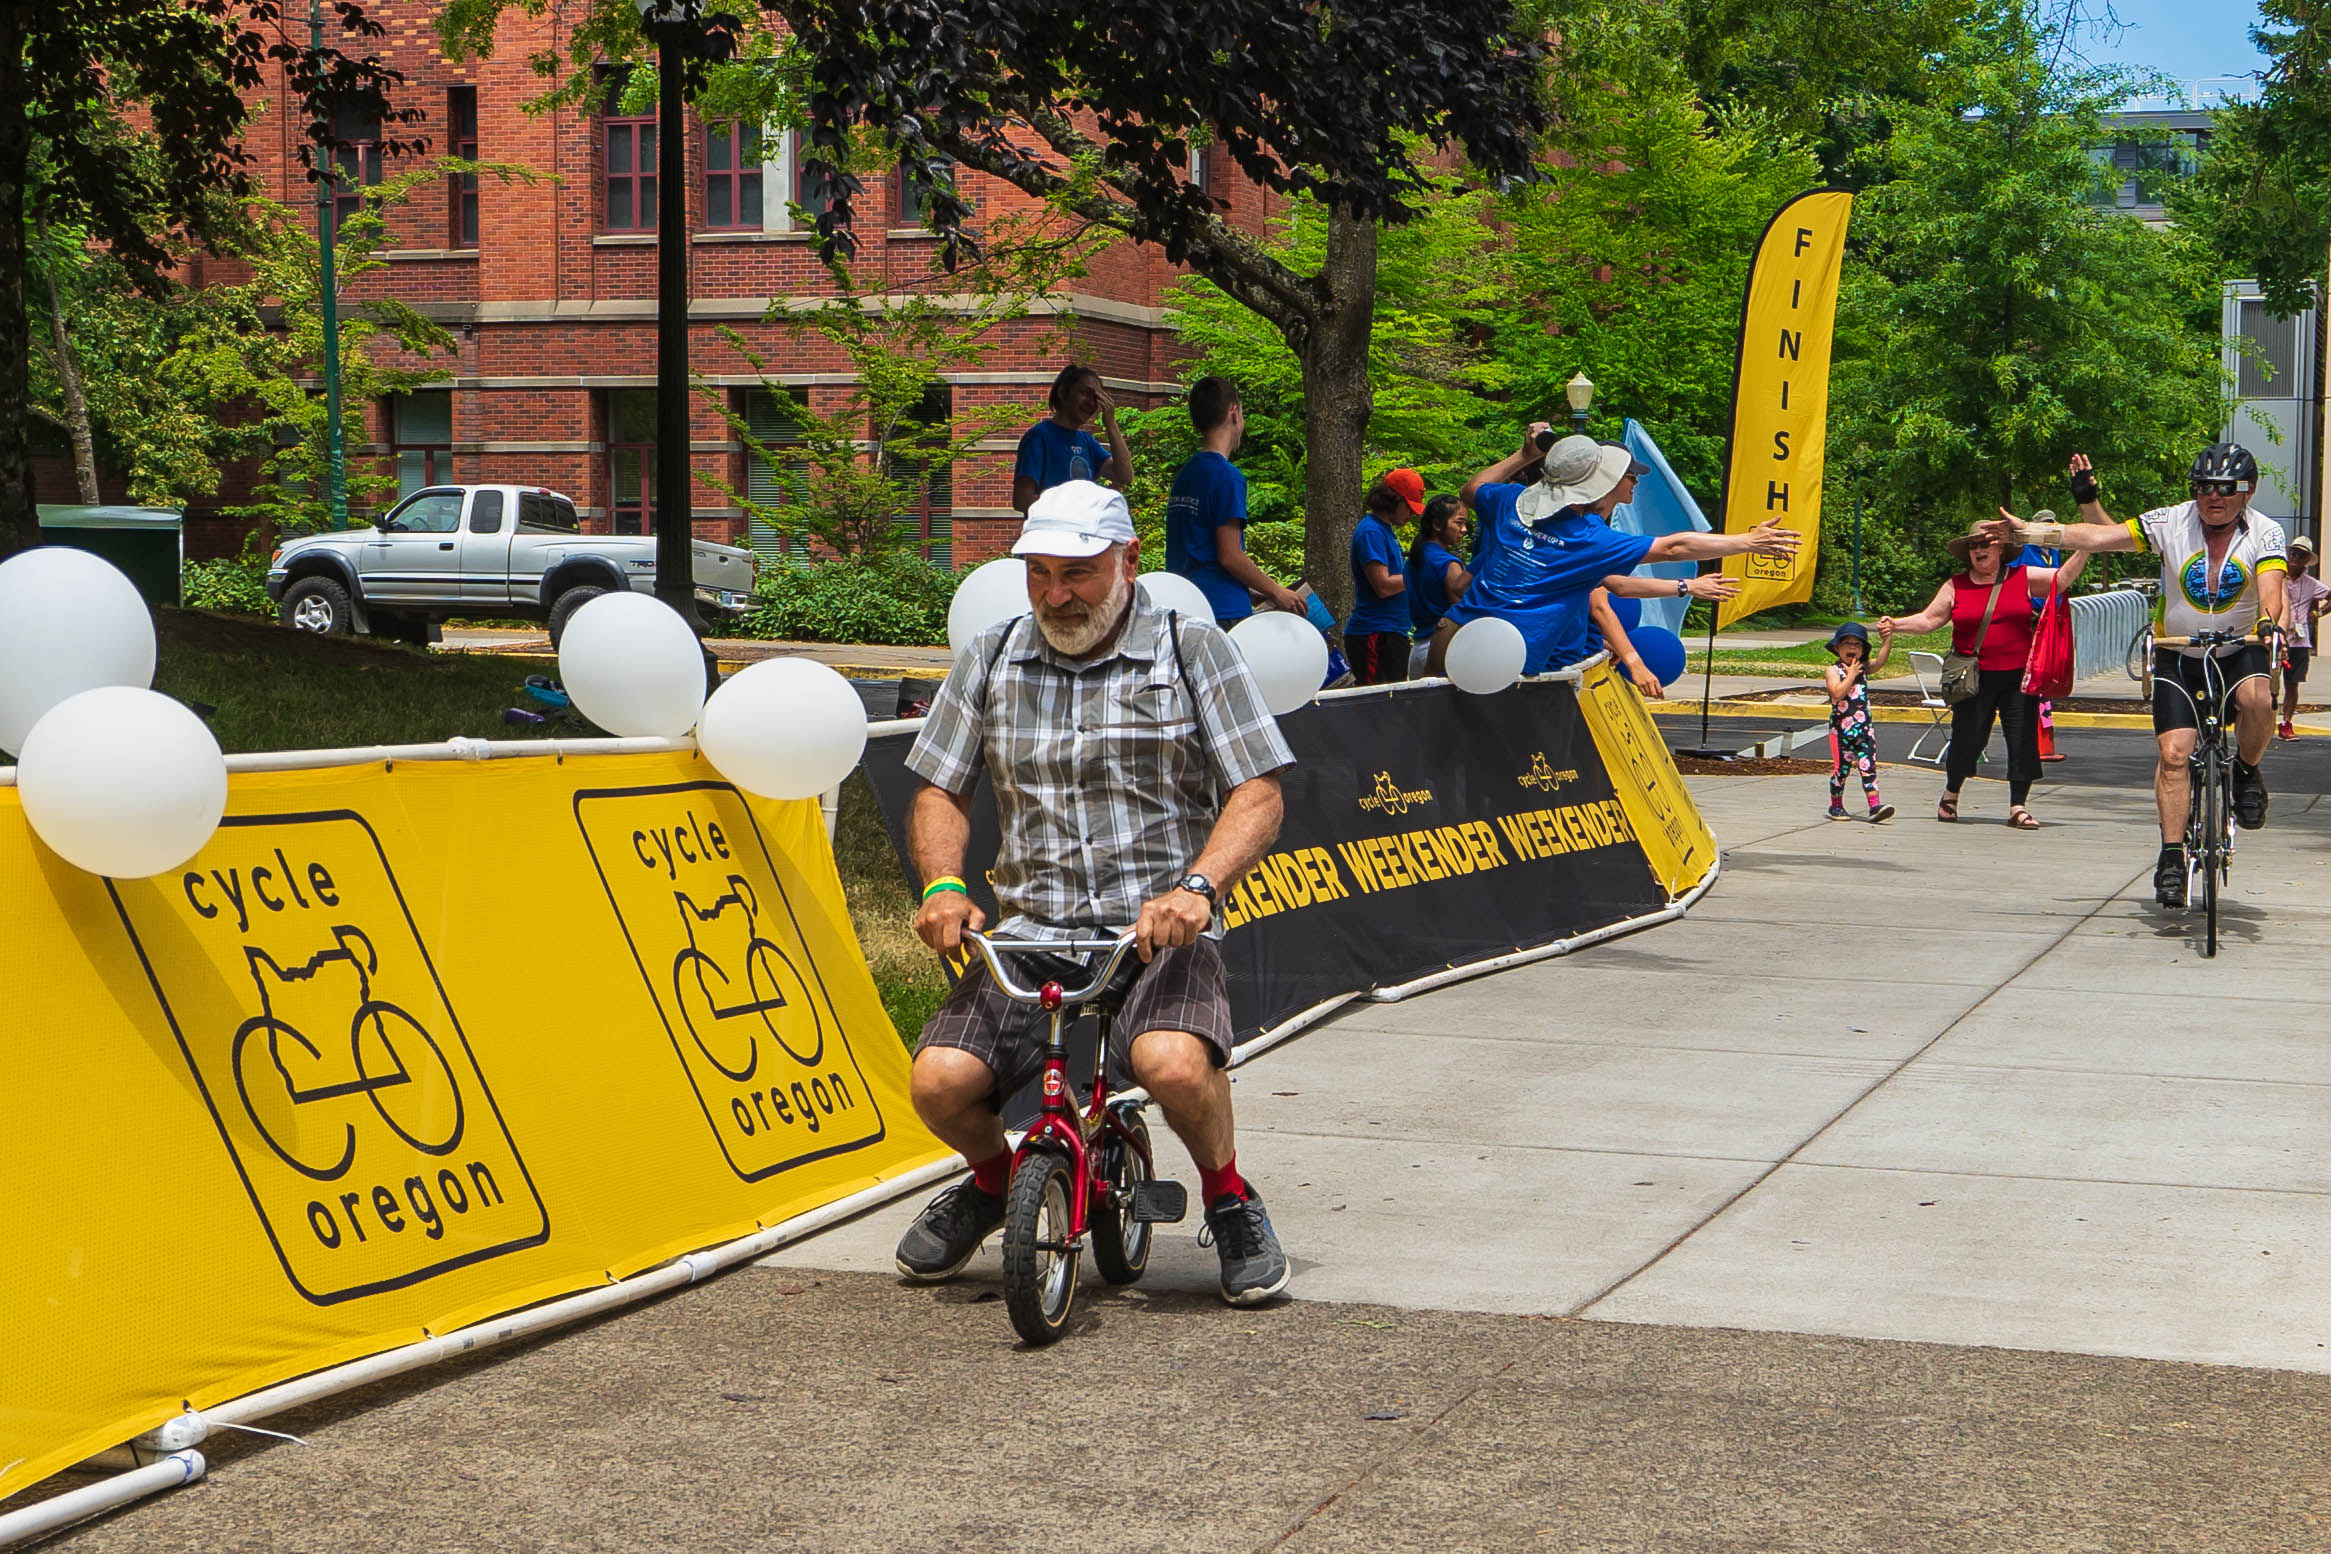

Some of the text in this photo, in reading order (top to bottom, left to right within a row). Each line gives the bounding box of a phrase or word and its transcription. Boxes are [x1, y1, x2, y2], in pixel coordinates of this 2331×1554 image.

[1767, 227, 1812, 512] FINISH
[1754, 568, 1786, 577] oregon
[1359, 789, 1432, 811] cycle oregon
[632, 811, 730, 880] cycle
[1337, 817, 1508, 895] WEEKENDER
[1498, 799, 1636, 861] WEEKENDER
[182, 848, 340, 932] cycle
[731, 1072, 854, 1137] oregon
[306, 1158, 504, 1250] oregon
